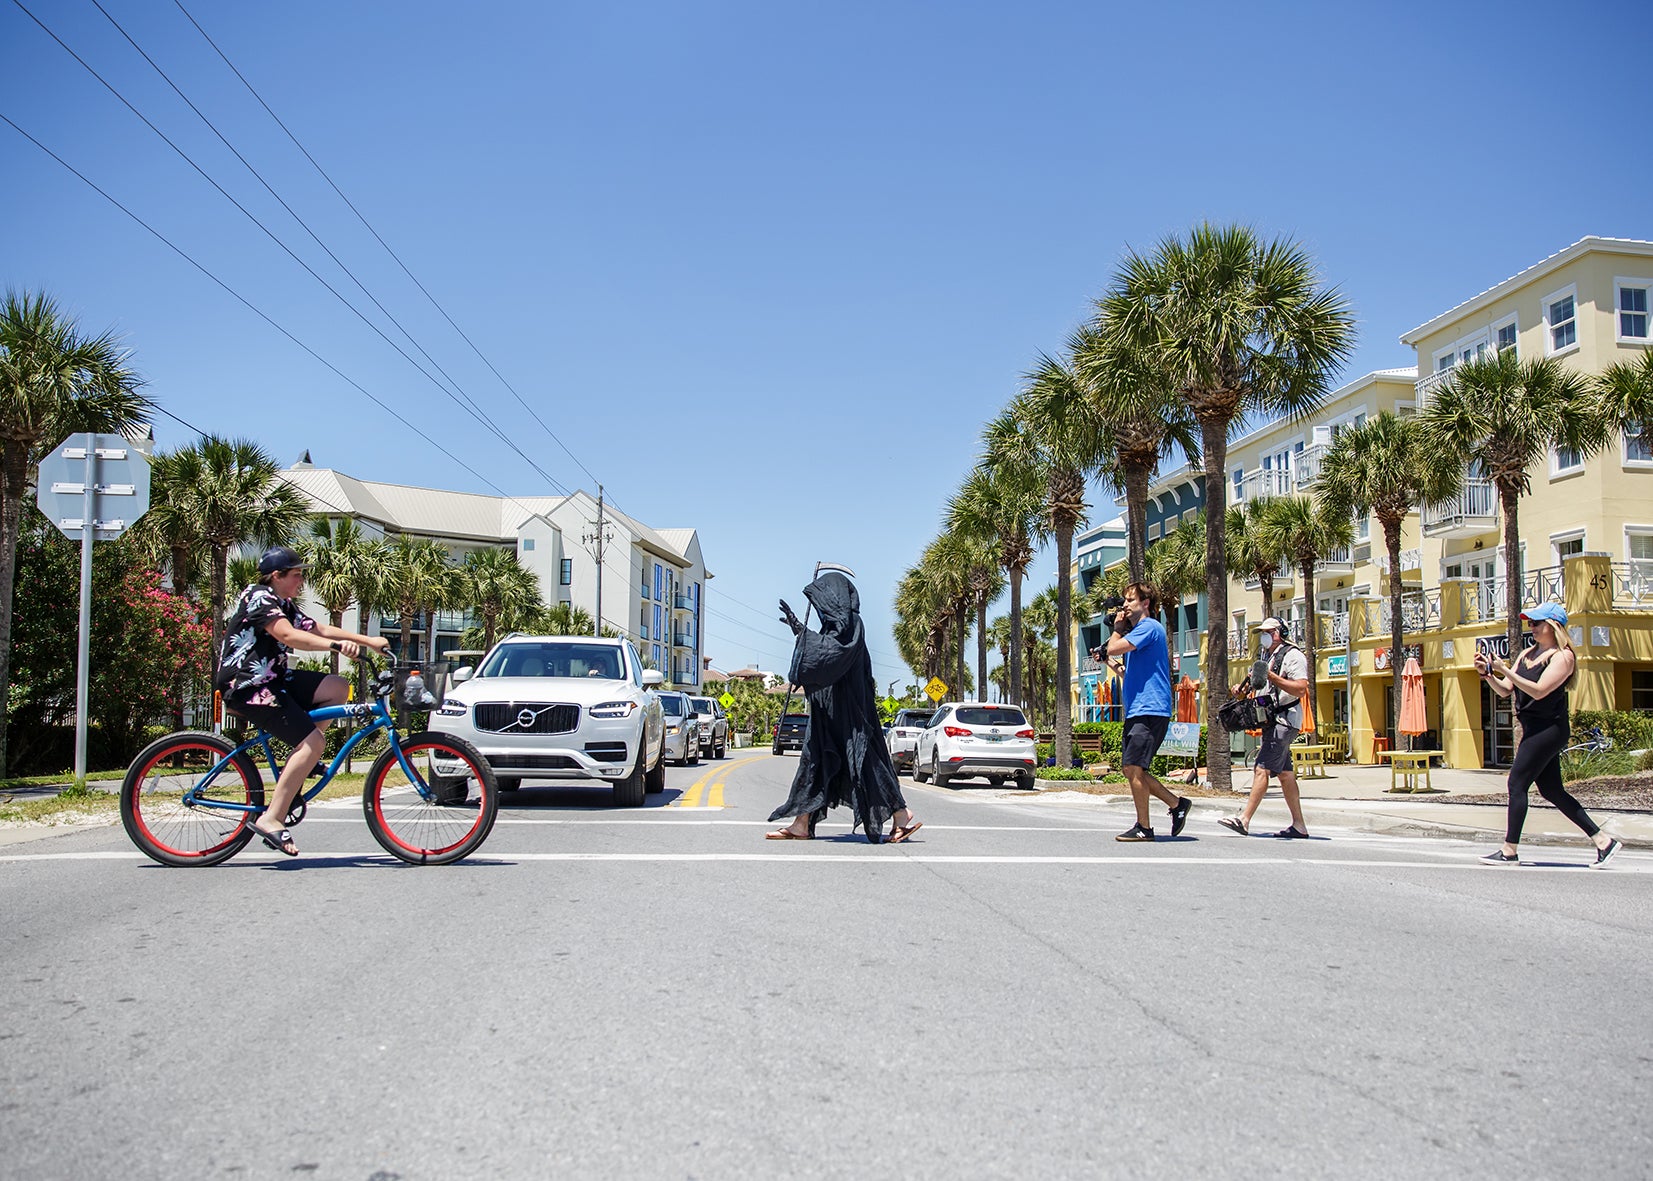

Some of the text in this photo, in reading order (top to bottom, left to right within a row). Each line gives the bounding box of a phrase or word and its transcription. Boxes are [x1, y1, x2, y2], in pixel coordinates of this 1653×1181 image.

[1590, 574, 1607, 590] 45
[1173, 727, 1186, 735] WE
[1162, 739, 1198, 749] WILL WIN
